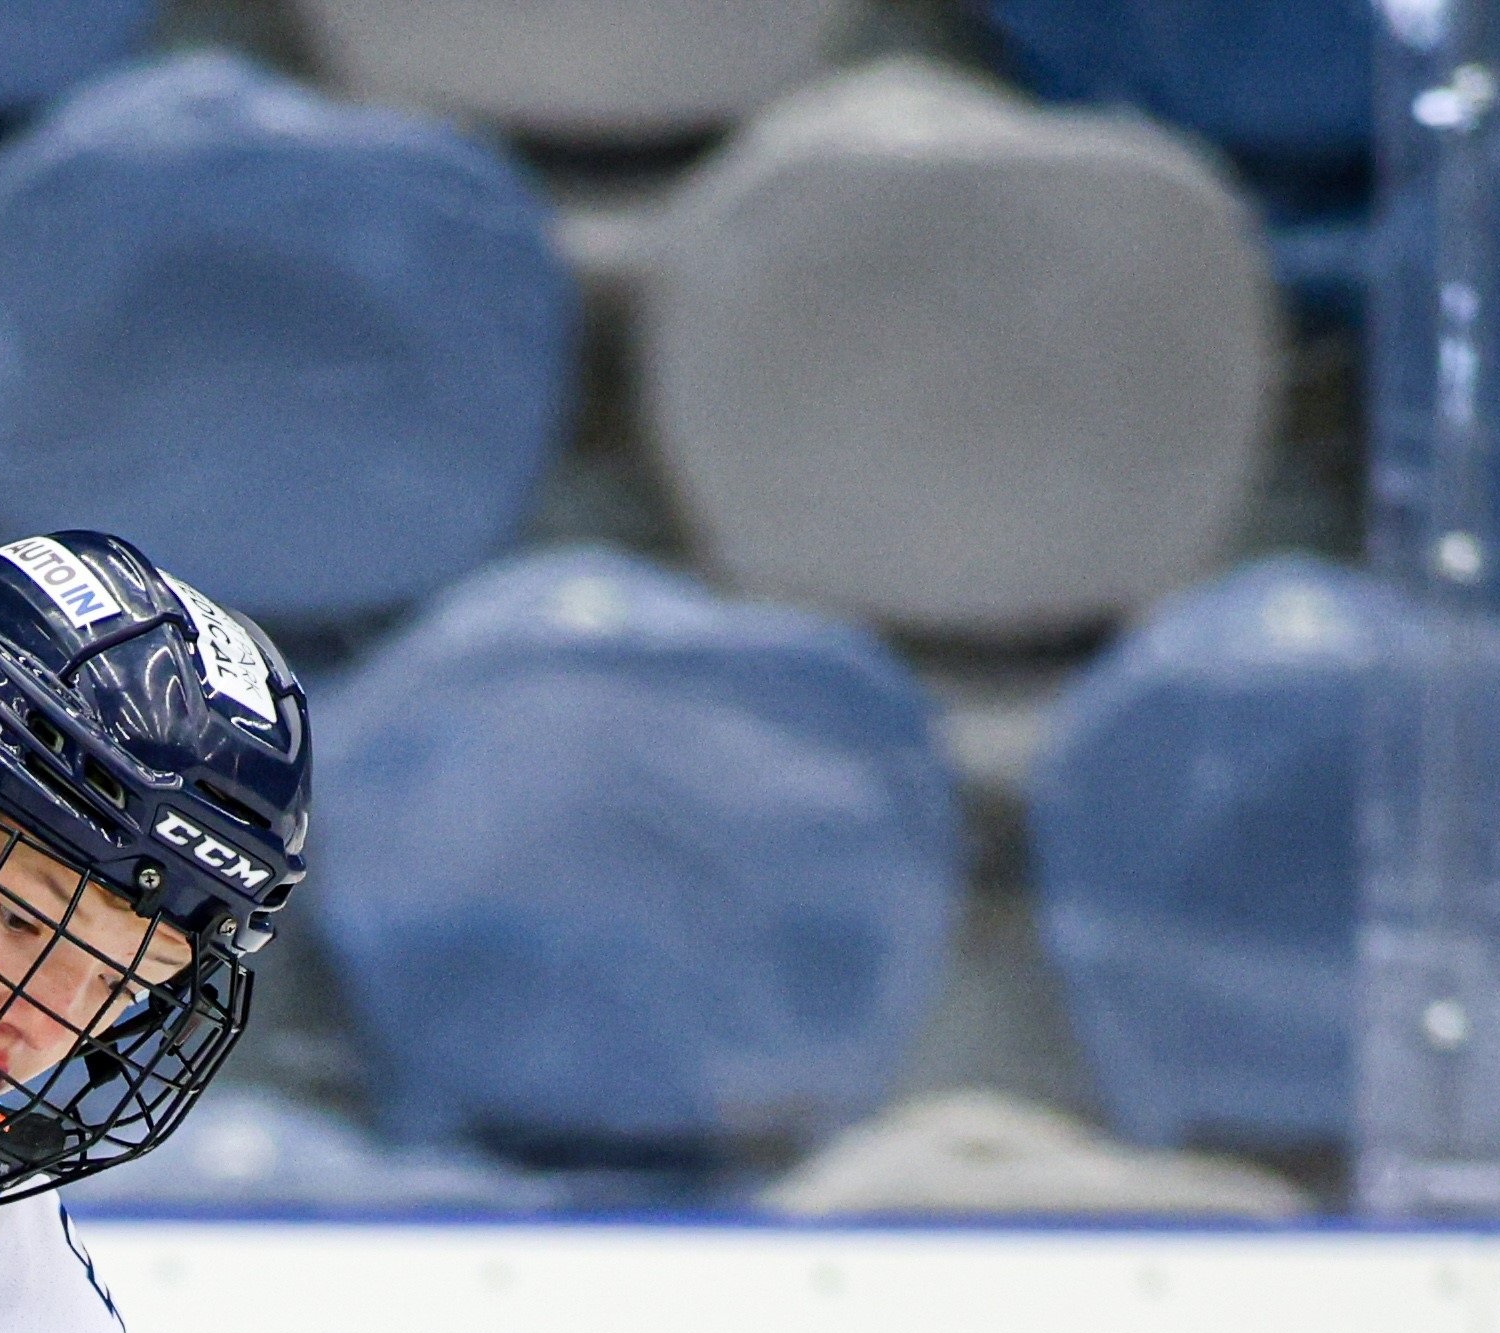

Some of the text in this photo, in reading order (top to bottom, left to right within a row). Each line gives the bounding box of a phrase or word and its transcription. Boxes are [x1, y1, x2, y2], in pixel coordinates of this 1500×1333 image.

[4, 540, 105, 618] AUTO IN
[155, 810, 270, 888] CCM
